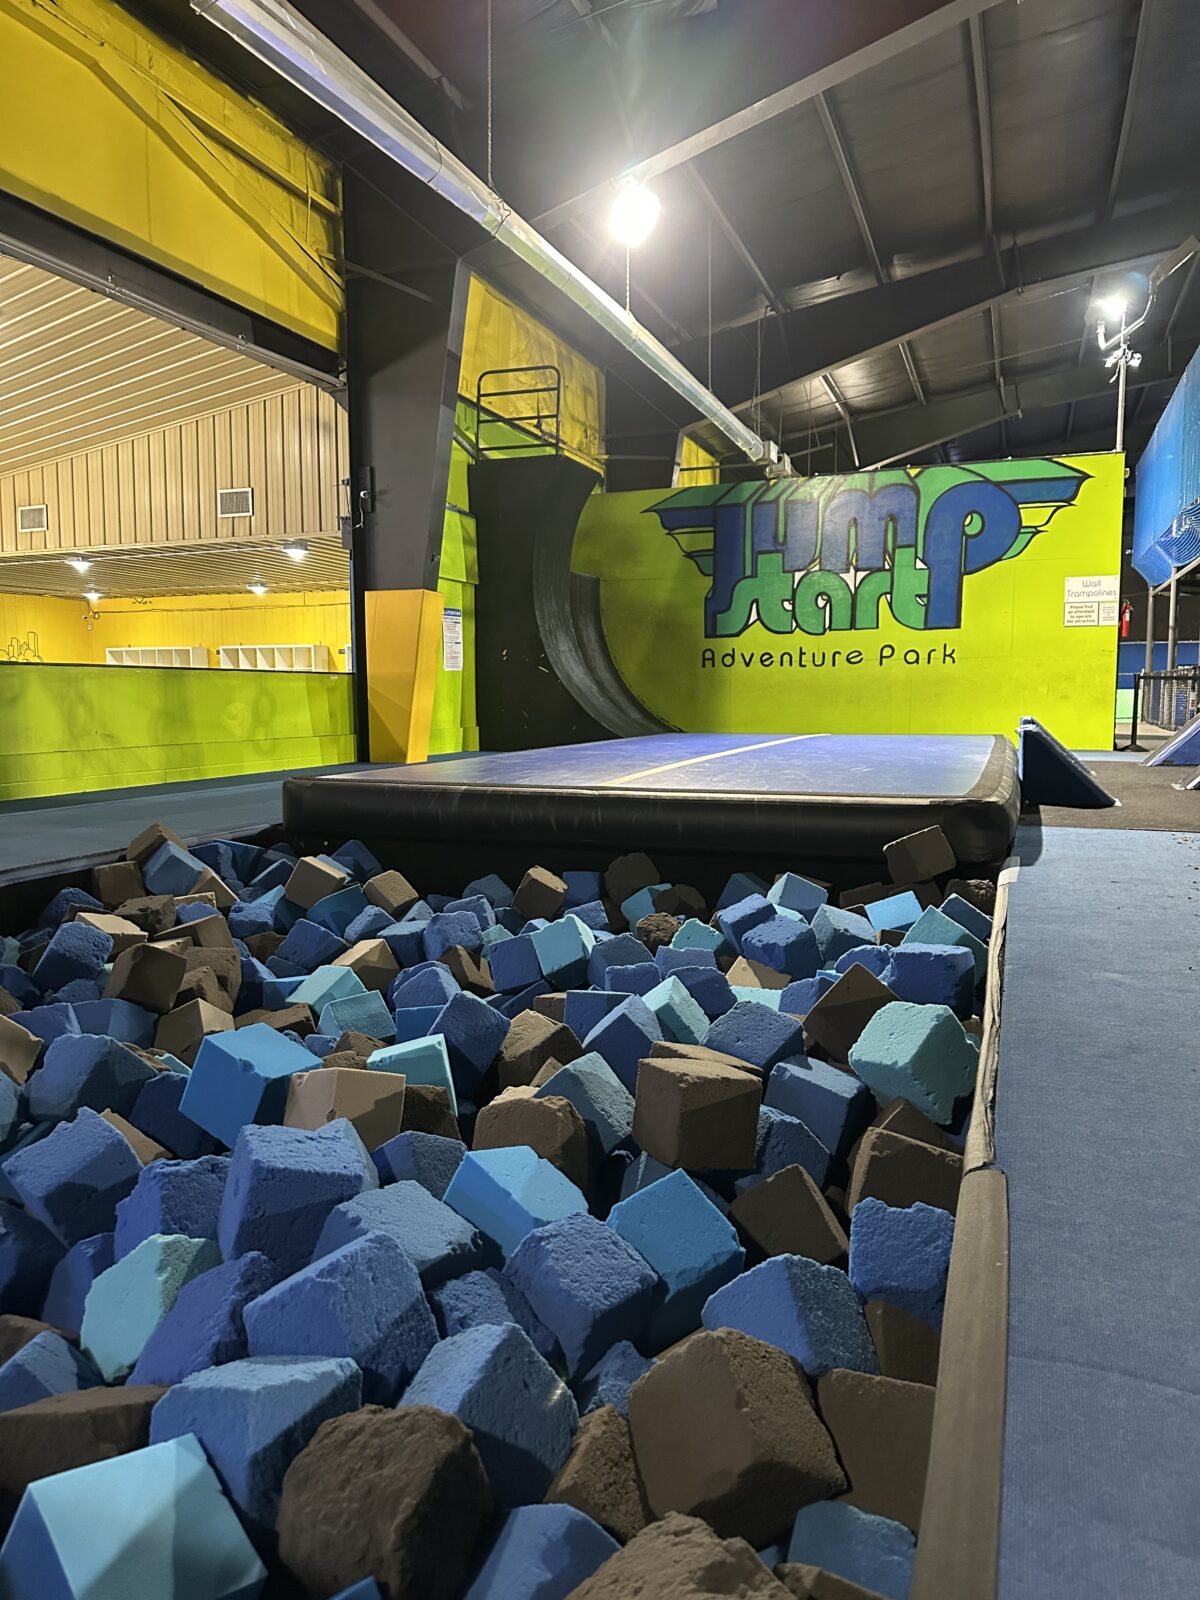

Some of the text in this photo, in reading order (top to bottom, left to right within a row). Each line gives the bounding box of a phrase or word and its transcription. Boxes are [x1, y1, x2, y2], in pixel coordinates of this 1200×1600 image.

[1082, 579, 1102, 588] Wall
[1066, 589, 1117, 598] Trampolines
[701, 643, 956, 668] Adventure Park
